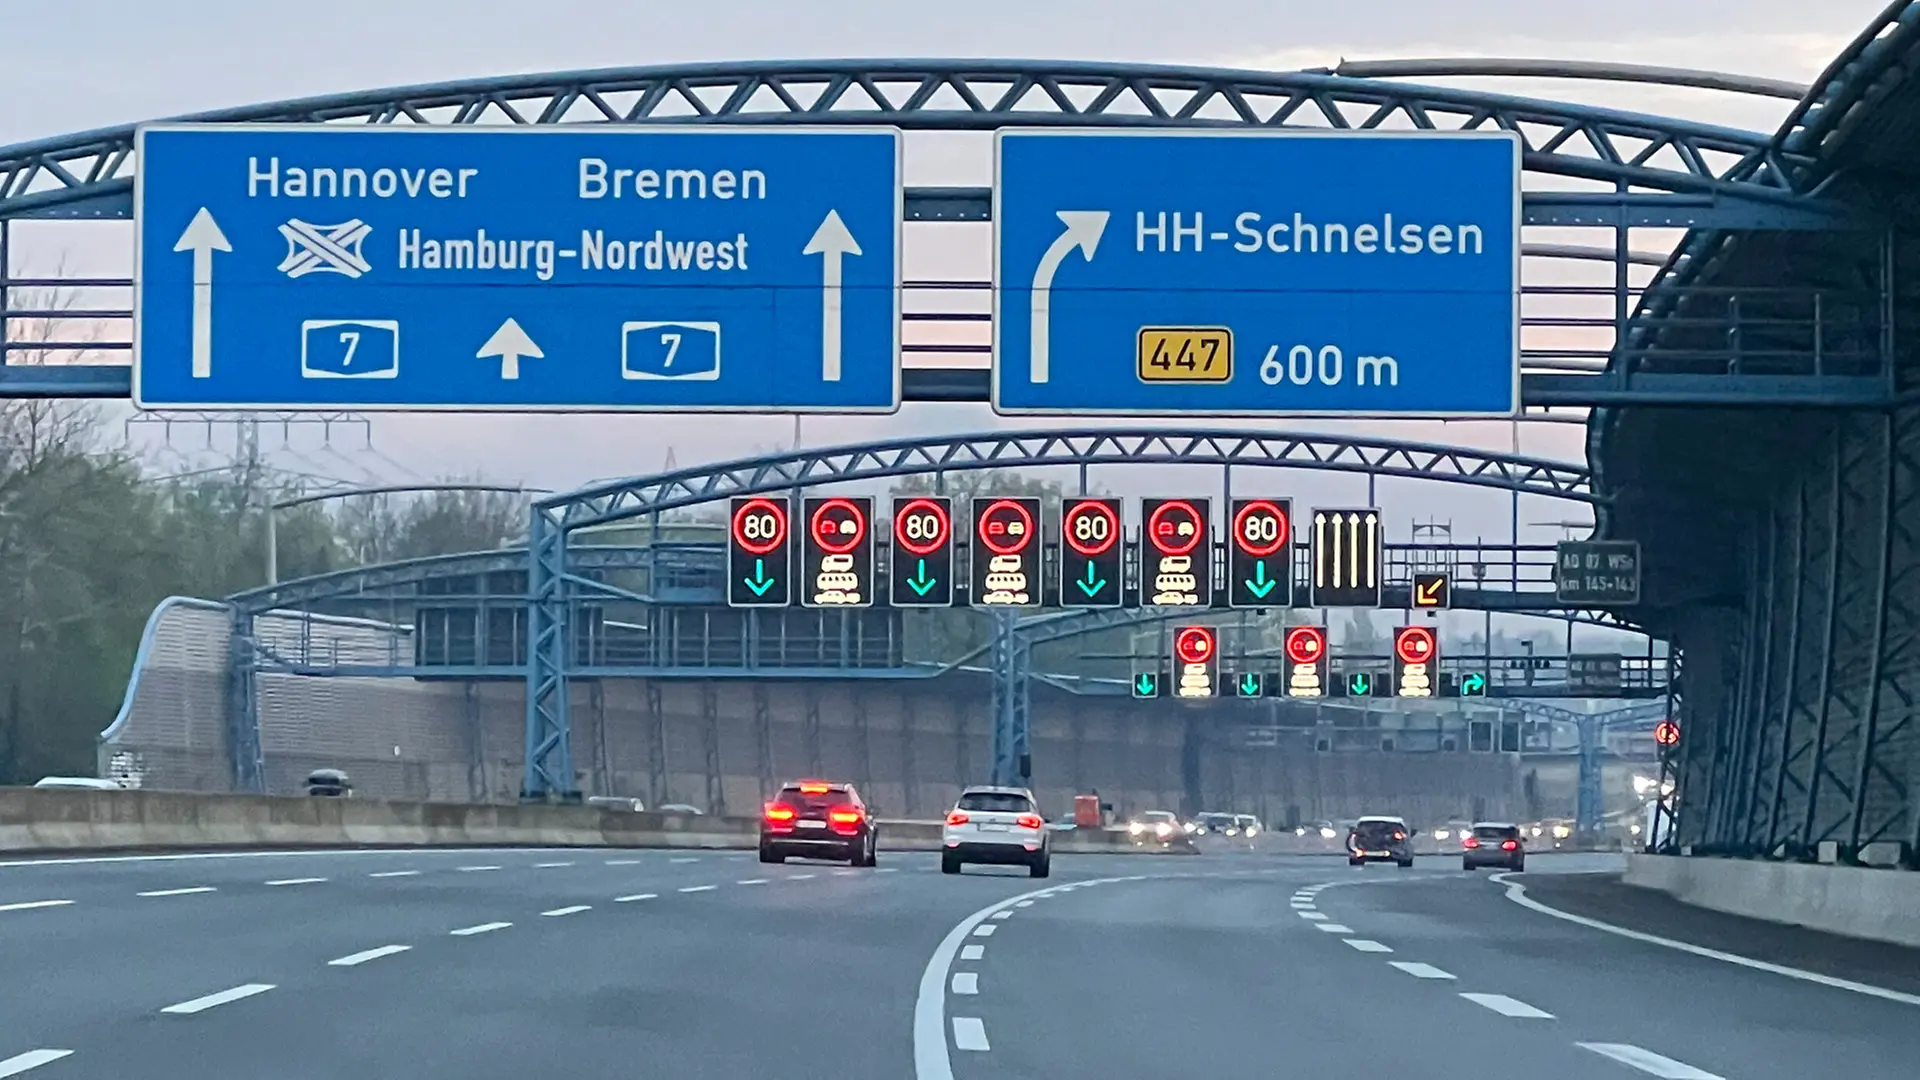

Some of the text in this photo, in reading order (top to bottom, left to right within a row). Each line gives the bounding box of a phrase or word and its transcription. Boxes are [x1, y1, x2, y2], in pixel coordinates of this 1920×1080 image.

[248, 157, 478, 198] Hannover
[579, 158, 767, 200] Bremen
[1136, 212, 1483, 255] HH-Schnelsen
[399, 229, 748, 281] Hamburg-Nordwest
[338, 332, 361, 367] 7
[659, 333, 683, 368] 7
[1150, 339, 1220, 372] 447
[1259, 345, 1398, 386] 600 m
[743, 514, 776, 539] 80
[906, 514, 939, 539] 80
[1075, 514, 1109, 540] 80
[1244, 515, 1278, 541] 80
